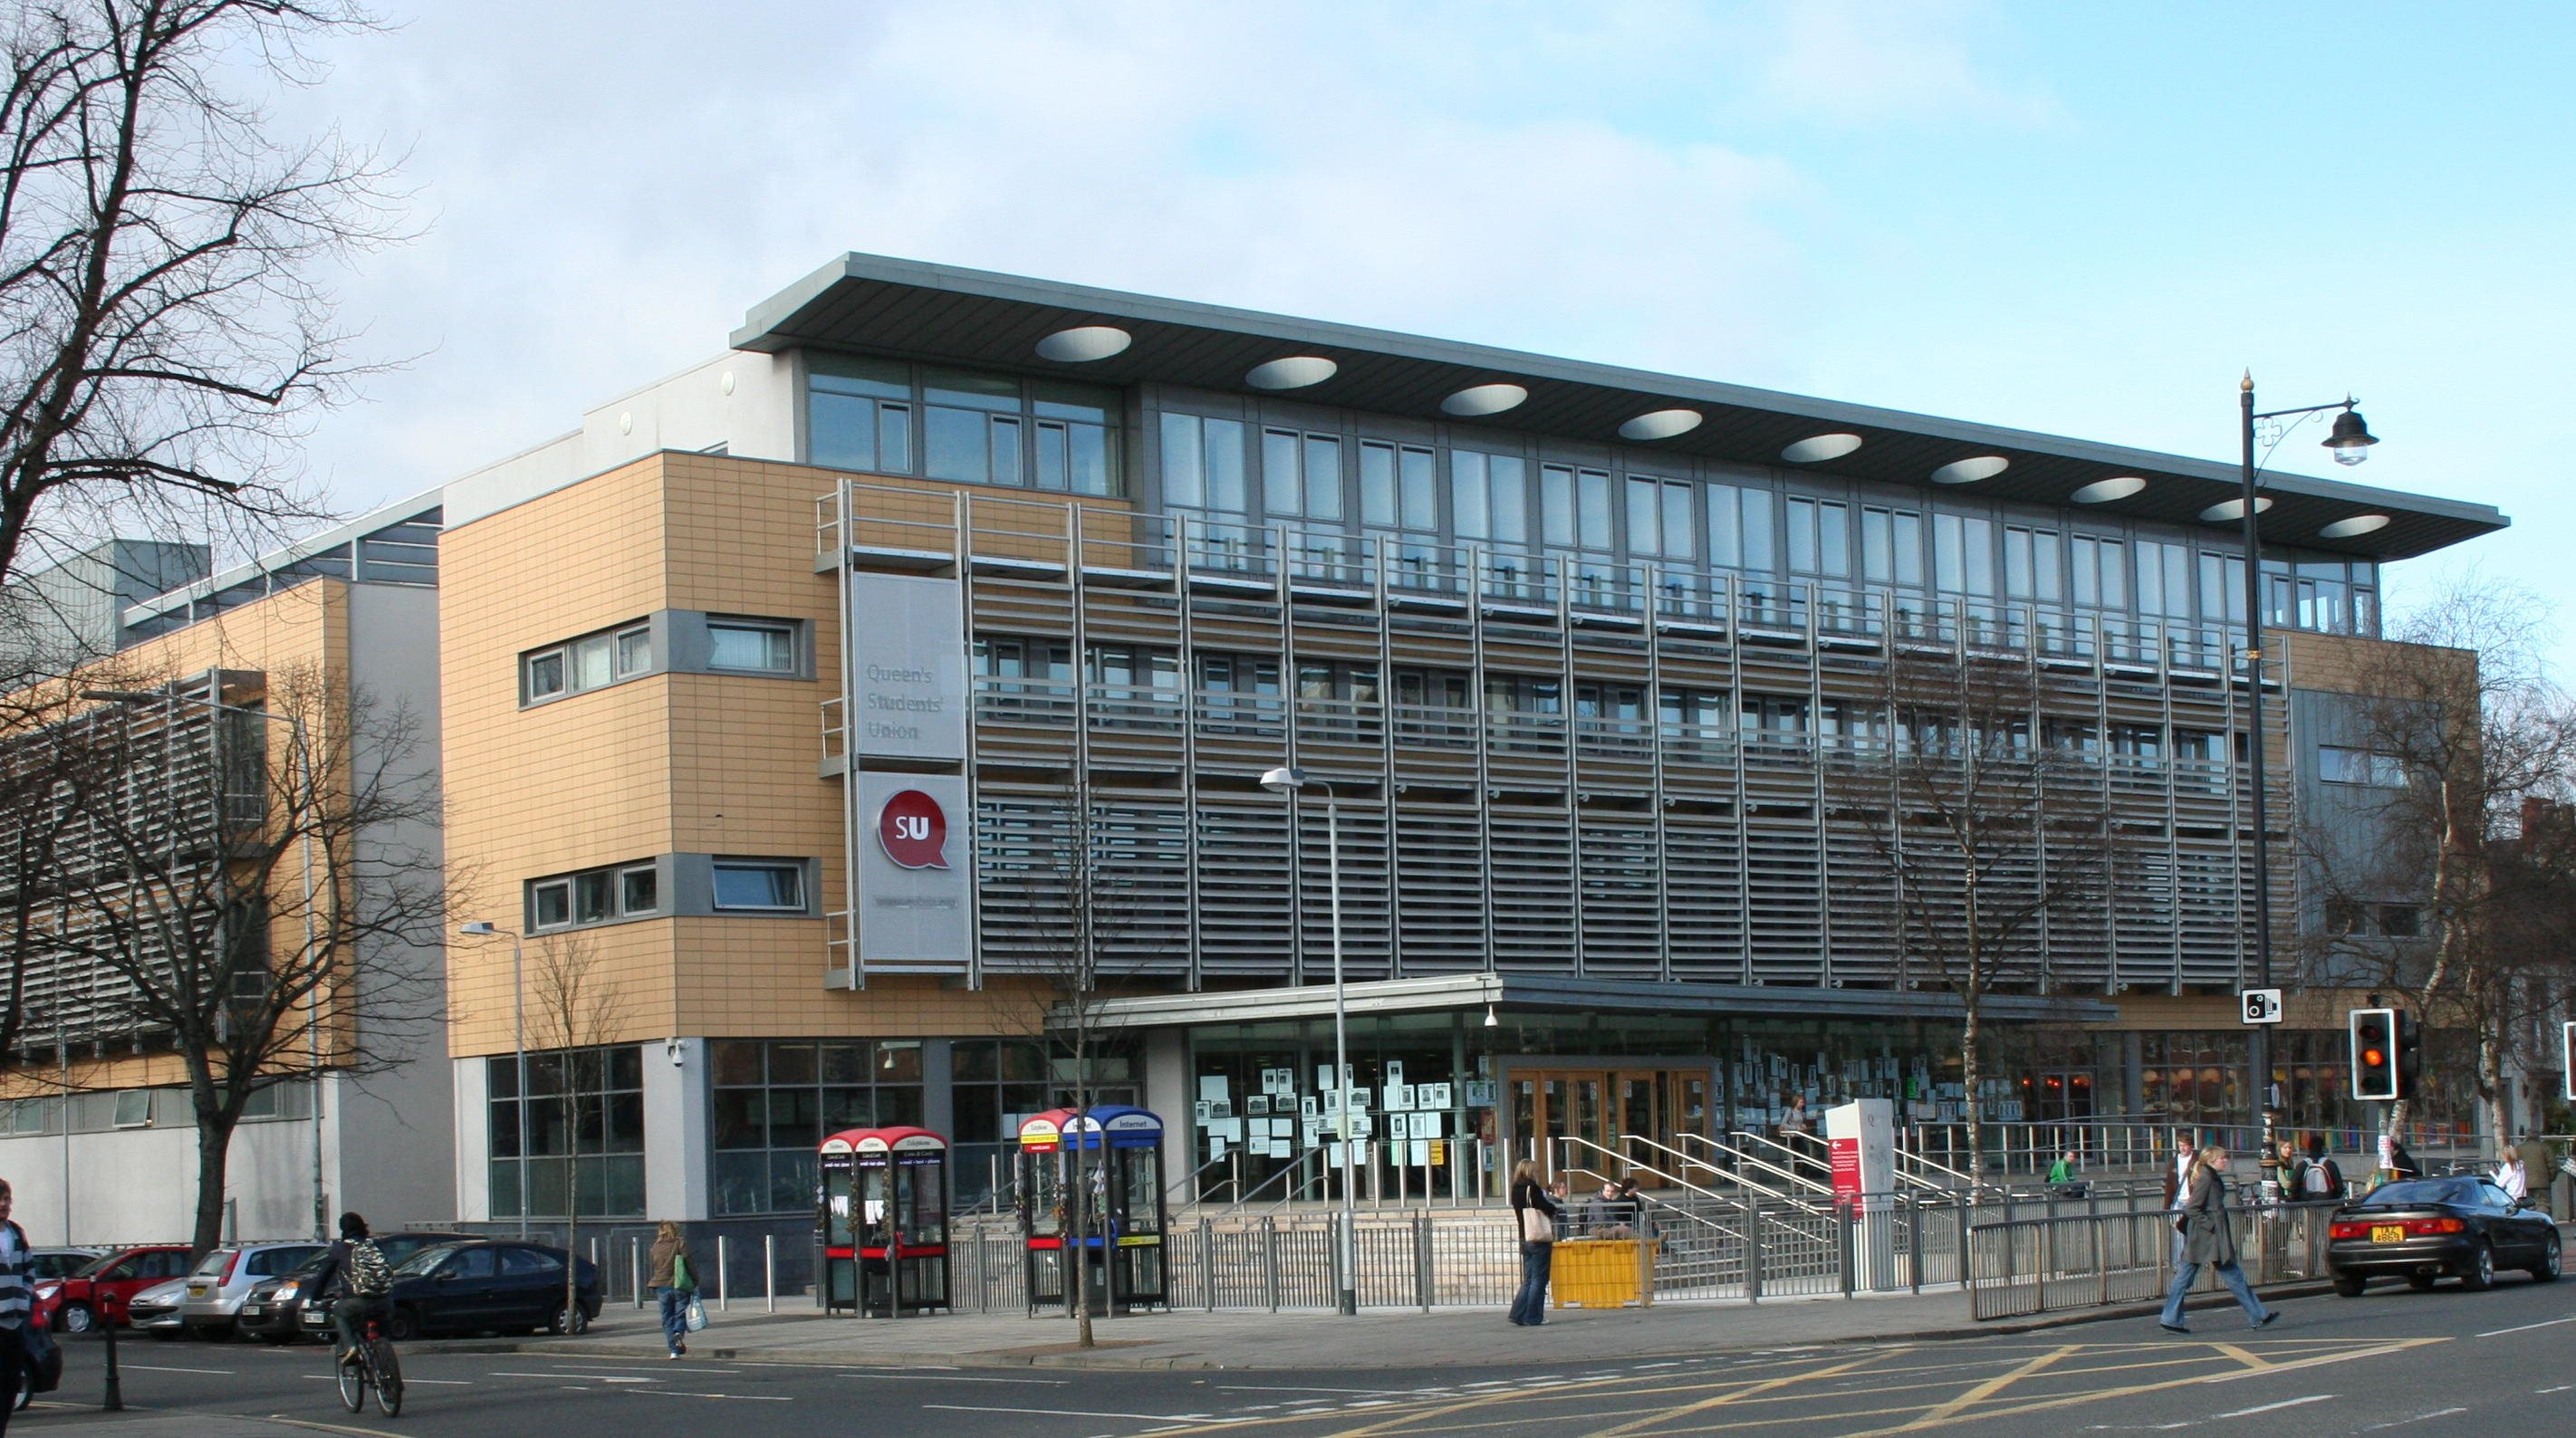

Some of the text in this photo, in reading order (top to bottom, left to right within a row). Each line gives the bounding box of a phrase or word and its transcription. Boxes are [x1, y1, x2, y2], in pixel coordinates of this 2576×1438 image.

[867, 664, 933, 684] Queen's
[868, 693, 945, 713] Students'
[867, 721, 918, 740] Union
[895, 815, 929, 840] SU
[1119, 1119, 1148, 1128] Internet
